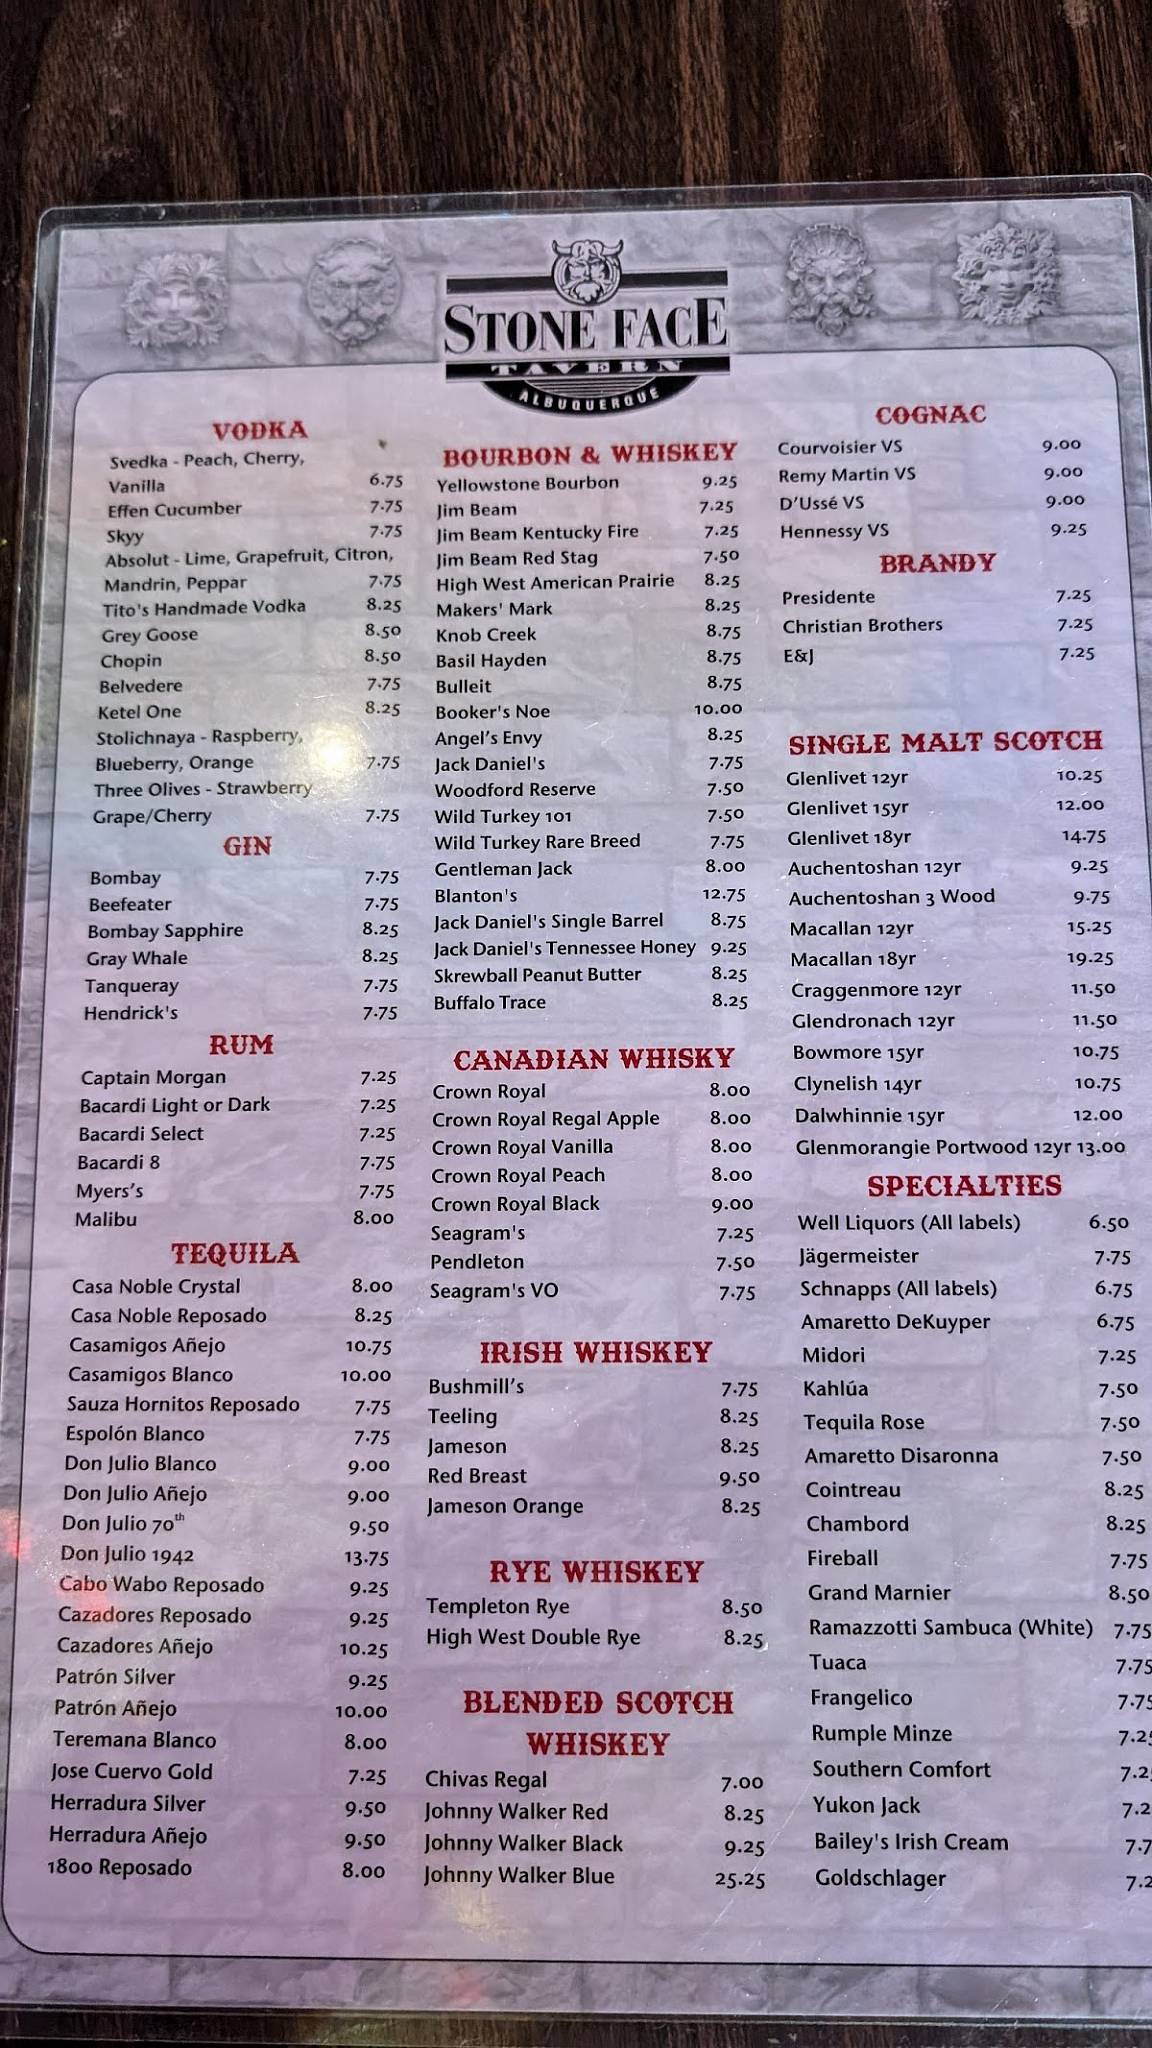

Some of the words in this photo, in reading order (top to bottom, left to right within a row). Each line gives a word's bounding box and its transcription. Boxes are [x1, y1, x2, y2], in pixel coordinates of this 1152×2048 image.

[444, 303, 596, 354] STONE
[614, 296, 728, 351] FACE
[491, 360, 683, 376] TAVERN
[519, 387, 661, 412] ALBUQUERQUE
[876, 405, 986, 424] COGNAC
[212, 420, 308, 440] VODKA
[778, 440, 876, 455] Courvoisier
[881, 440, 902, 452] VS
[1042, 440, 1081, 452] 9.00
[444, 446, 570, 467] BOURBON
[581, 446, 600, 464] &
[611, 442, 738, 463] WHISKEY
[109, 480, 164, 494] Vanilla
[370, 473, 402, 488] 6.75
[437, 478, 540, 492] Yellowstone
[546, 476, 618, 490] Bourbon
[702, 476, 737, 490] 9.25
[108, 504, 148, 518] Effen
[154, 502, 242, 516] Cucumber
[370, 500, 402, 514] 7.75
[437, 504, 464, 520] Jim
[470, 504, 516, 516] Beam
[700, 500, 734, 514] 7.25
[107, 530, 144, 546] Skyy
[370, 525, 402, 538] 7.75
[781, 525, 862, 541] Hennessy
[868, 524, 888, 536] VS
[1051, 524, 1086, 536] 9.25
[880, 553, 996, 573] BRANDY
[438, 578, 477, 595] High
[483, 578, 525, 590] West
[531, 576, 612, 590] American
[619, 574, 674, 588] Prairie
[705, 573, 740, 588] 8.25
[783, 590, 874, 604] Presidente
[1056, 590, 1091, 603] 7.25
[102, 630, 141, 646] Grey
[146, 628, 198, 642] Goose
[366, 624, 401, 639] 8.50
[437, 628, 481, 642] Knob
[488, 627, 536, 641] Creek
[706, 624, 740, 640] 8.75
[100, 654, 162, 672] Chopin
[364, 649, 400, 665] 8.50
[790, 734, 890, 755] SINGLE
[902, 732, 982, 752] MALT
[994, 730, 1103, 751] SCOTCH
[787, 771, 866, 786] Glenlivet
[872, 774, 908, 788] 12yr
[1057, 770, 1102, 784] 10.25
[435, 782, 523, 797] Woodford
[530, 783, 595, 796] Reserve
[708, 782, 744, 796] 7.50
[224, 836, 272, 856] GIN
[435, 862, 531, 876] Gentleman
[538, 860, 572, 878] Jack
[706, 859, 745, 872] 8.00
[90, 870, 161, 888] Bombay
[366, 871, 398, 884] 7.75
[789, 890, 920, 906] Auchentoshan
[926, 893, 934, 906] 3
[940, 888, 994, 903] Wood
[1074, 891, 1110, 904] 9.75
[88, 924, 159, 942] Bombay
[164, 922, 243, 942] Sapphire
[363, 922, 398, 938] 8.25
[792, 952, 872, 966] Macallan
[878, 952, 916, 970] 18yr
[1068, 952, 1113, 966] 19.25
[85, 979, 179, 997] Tanqueray
[364, 979, 398, 992] 7.75
[210, 1034, 274, 1054] RUM
[454, 1049, 608, 1070] CANADIAN
[619, 1048, 735, 1068] WHISKY
[82, 1070, 150, 1090] Captain
[156, 1070, 226, 1088] Morgan
[362, 1071, 396, 1085] 7.25
[434, 1085, 491, 1099] Crown
[498, 1084, 545, 1102] Royal
[710, 1083, 750, 1096] 8.00
[432, 1140, 490, 1155] Crown
[498, 1139, 545, 1159] Royal
[552, 1138, 612, 1154] Vanilla
[711, 1139, 751, 1152] 8.00
[868, 1175, 1062, 1196] SPECIALTIES
[76, 1212, 136, 1226] Malibu
[354, 1210, 394, 1224] 8.00
[798, 1214, 838, 1230] Well
[846, 1215, 914, 1234] Liquors
[922, 1214, 952, 1234] (All
[960, 1214, 1020, 1233] labels)
[1090, 1214, 1128, 1232] 6.50
[172, 1242, 300, 1267] TEQUILA
[432, 1254, 524, 1269] Pendleton
[717, 1257, 754, 1271] 7.50
[72, 1279, 112, 1294] Casa
[120, 1278, 172, 1294] Noble
[178, 1278, 240, 1298] Crystal
[352, 1278, 392, 1292] 8.00
[480, 1342, 562, 1364] IRISH
[574, 1342, 712, 1363] WHISKEY
[804, 1347, 864, 1362] Midori
[1098, 1350, 1136, 1364] 7.25
[428, 1408, 496, 1428] Teeling
[720, 1408, 758, 1426] 8.25
[804, 1414, 874, 1434] Tequila
[882, 1414, 924, 1430] Rose
[1101, 1417, 1140, 1432] 7.50
[66, 1456, 102, 1470] Don
[108, 1455, 148, 1474] Julio
[156, 1456, 216, 1471] Blanco
[348, 1460, 390, 1475] 9.00
[429, 1468, 462, 1484] Red
[470, 1468, 526, 1484] Breast
[720, 1472, 760, 1486] 9.50
[808, 1550, 878, 1566] Fireball
[490, 1560, 550, 1582] RYE
[562, 1560, 704, 1583] WHISKEY
[809, 1584, 868, 1600] Grand
[875, 1584, 951, 1600] Marnier
[426, 1598, 529, 1618] Templeton
[537, 1598, 569, 1618] Rye
[722, 1599, 762, 1618] 8.50
[56, 1668, 116, 1684] Patrón
[124, 1668, 176, 1685] Silver
[348, 1674, 388, 1690] 9.25
[464, 1690, 603, 1714] BLENDED
[617, 1692, 734, 1714] SCOTCH
[812, 1689, 912, 1710] Frangelico
[54, 1730, 146, 1748] Teremana
[154, 1731, 216, 1748] Blanco
[345, 1734, 386, 1750] 8.00
[526, 1732, 670, 1756] WHISKEY
[813, 1760, 902, 1777] Southern
[910, 1760, 991, 1778] Comfort
[426, 1770, 488, 1787] Chivas
[495, 1770, 546, 1792] Regal
[722, 1777, 764, 1792] 7.00
[424, 1802, 492, 1824] Johnny
[498, 1802, 566, 1820] Walker
[573, 1803, 608, 1820] Red
[724, 1805, 764, 1824] 8.25
[48, 1858, 92, 1874] 1800
[100, 1858, 192, 1880] Reposado
[343, 1862, 385, 1878] 8.00
[424, 1866, 492, 1888] Johnny
[498, 1866, 566, 1884] Walker
[574, 1867, 614, 1884] Blue
[716, 1873, 765, 1889] 25.25
[816, 1868, 946, 1892] Goldschlager
